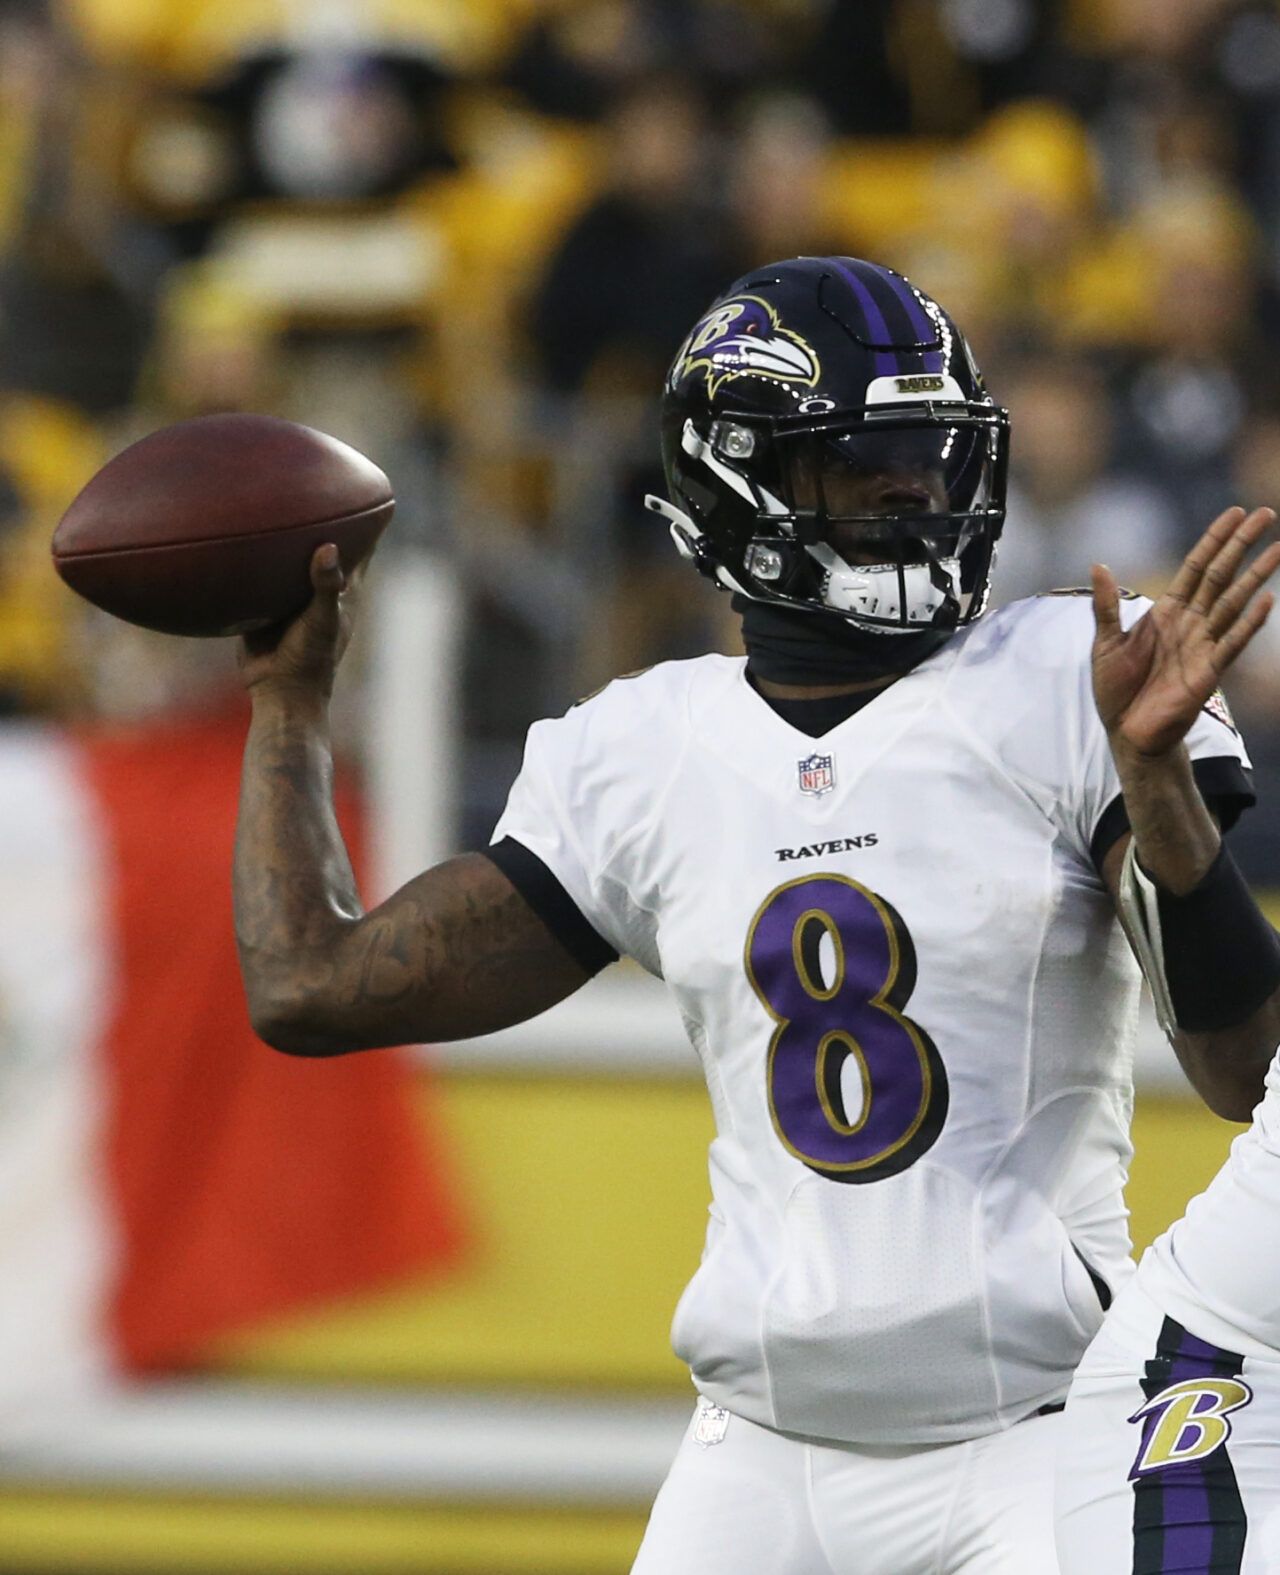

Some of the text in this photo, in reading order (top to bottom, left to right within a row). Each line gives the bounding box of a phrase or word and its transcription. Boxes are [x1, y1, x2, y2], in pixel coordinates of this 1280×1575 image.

[803, 769, 830, 788] NFL
[774, 833, 879, 861] RAVENS
[744, 872, 950, 1185] 8
